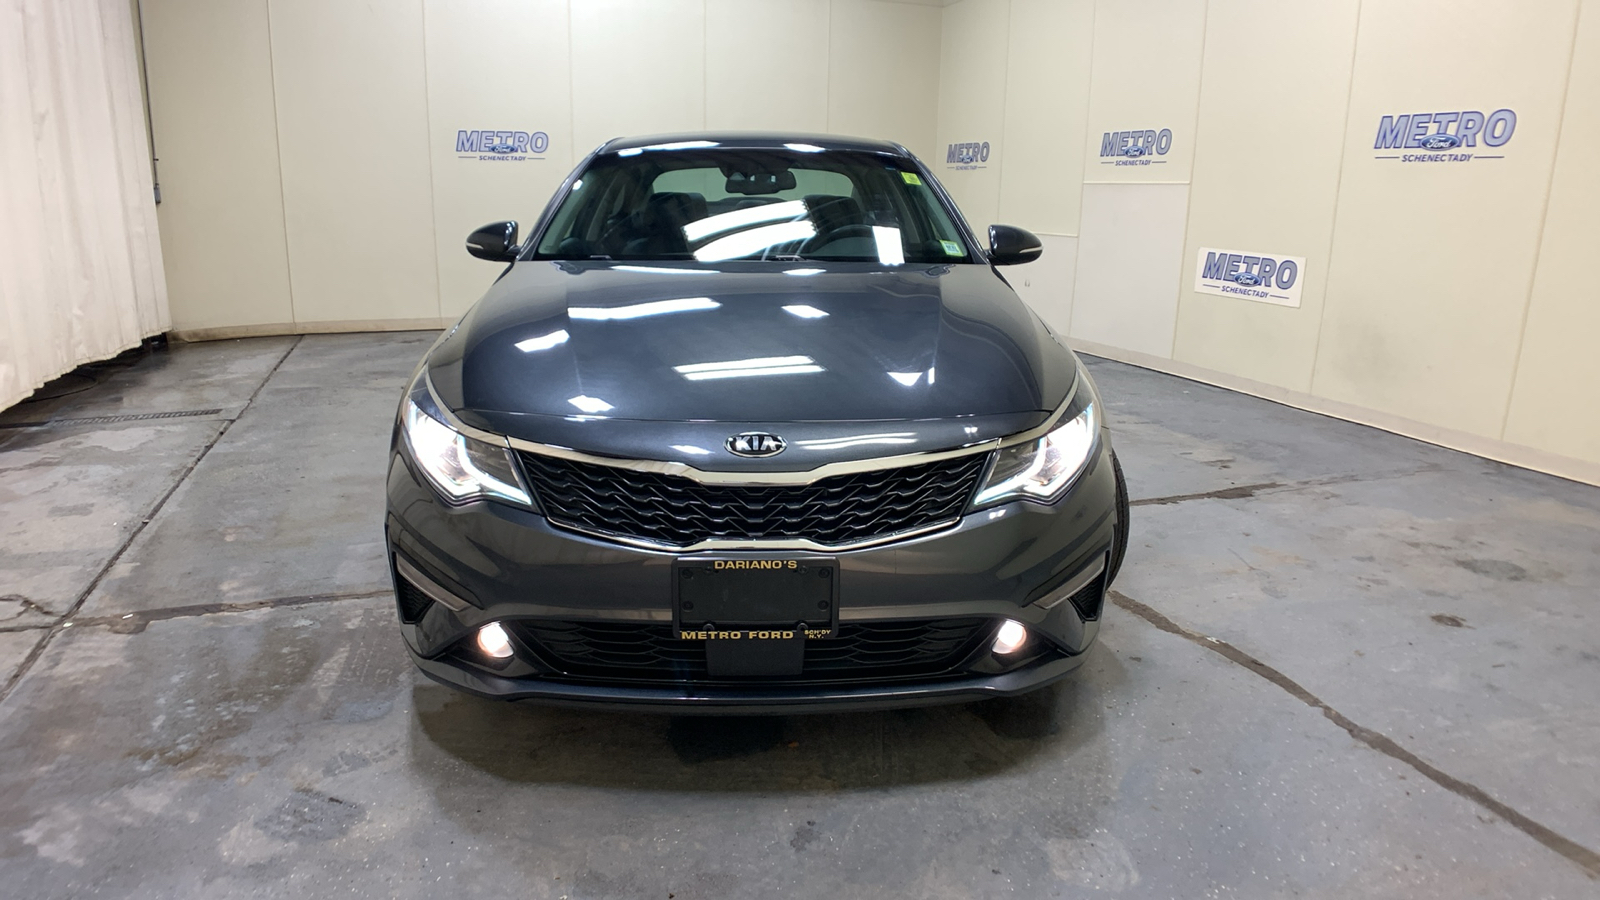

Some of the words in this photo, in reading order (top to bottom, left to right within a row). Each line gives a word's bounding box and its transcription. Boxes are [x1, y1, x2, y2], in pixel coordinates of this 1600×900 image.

[1374, 108, 1517, 149] METRO
[456, 130, 549, 153] METRO
[1100, 128, 1173, 157] METRO
[1426, 137, 1452, 148] Ford
[946, 141, 990, 163] METRO
[1401, 153, 1473, 162] SCHENECTADY
[1202, 251, 1298, 290] METRO
[1221, 285, 1269, 298] SCHENECTADY
[735, 436, 777, 451] KIA
[714, 560, 798, 569] DARIANO'S
[681, 631, 741, 640] METRO
[749, 631, 794, 640] FORD
